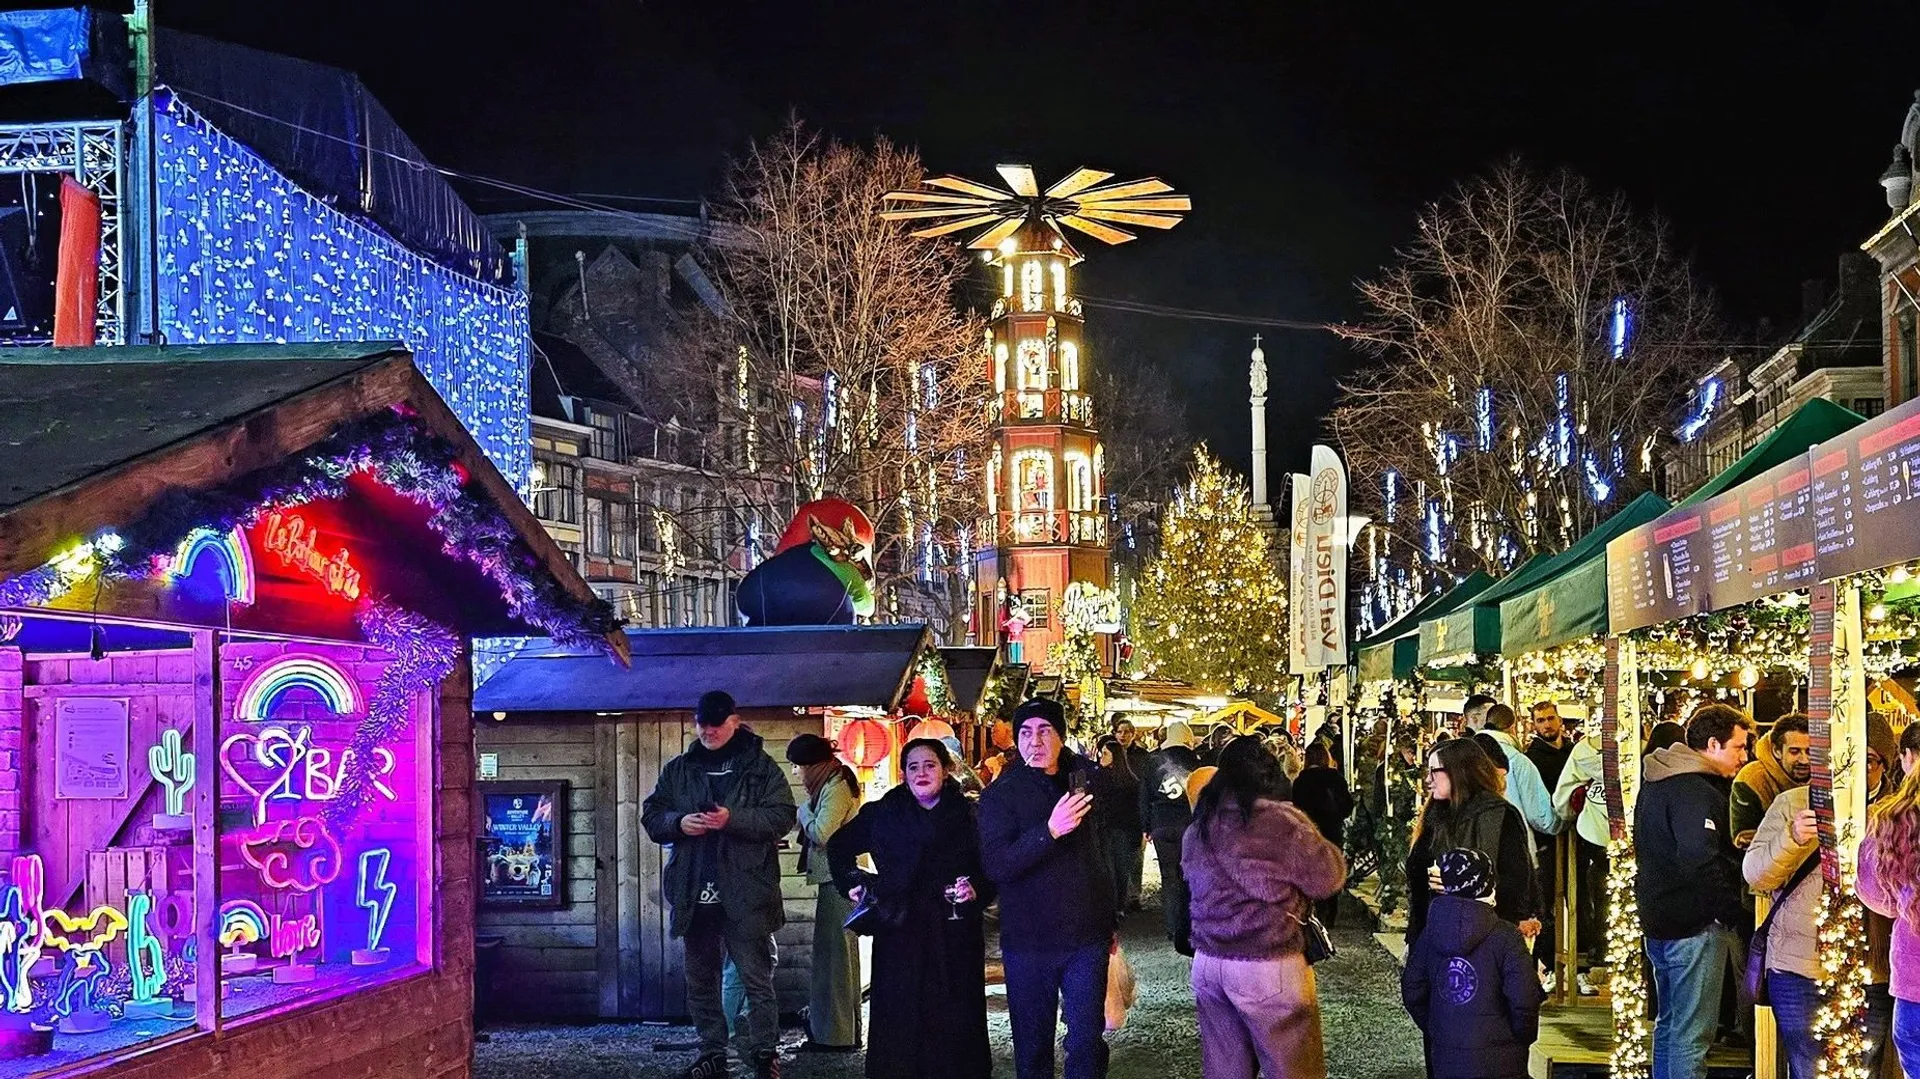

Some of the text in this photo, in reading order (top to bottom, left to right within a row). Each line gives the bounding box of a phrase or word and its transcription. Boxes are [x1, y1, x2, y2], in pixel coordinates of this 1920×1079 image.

[233, 655, 254, 672] 45
[492, 823, 542, 831] WINTER VALLEY
[271, 914, 321, 959] love
